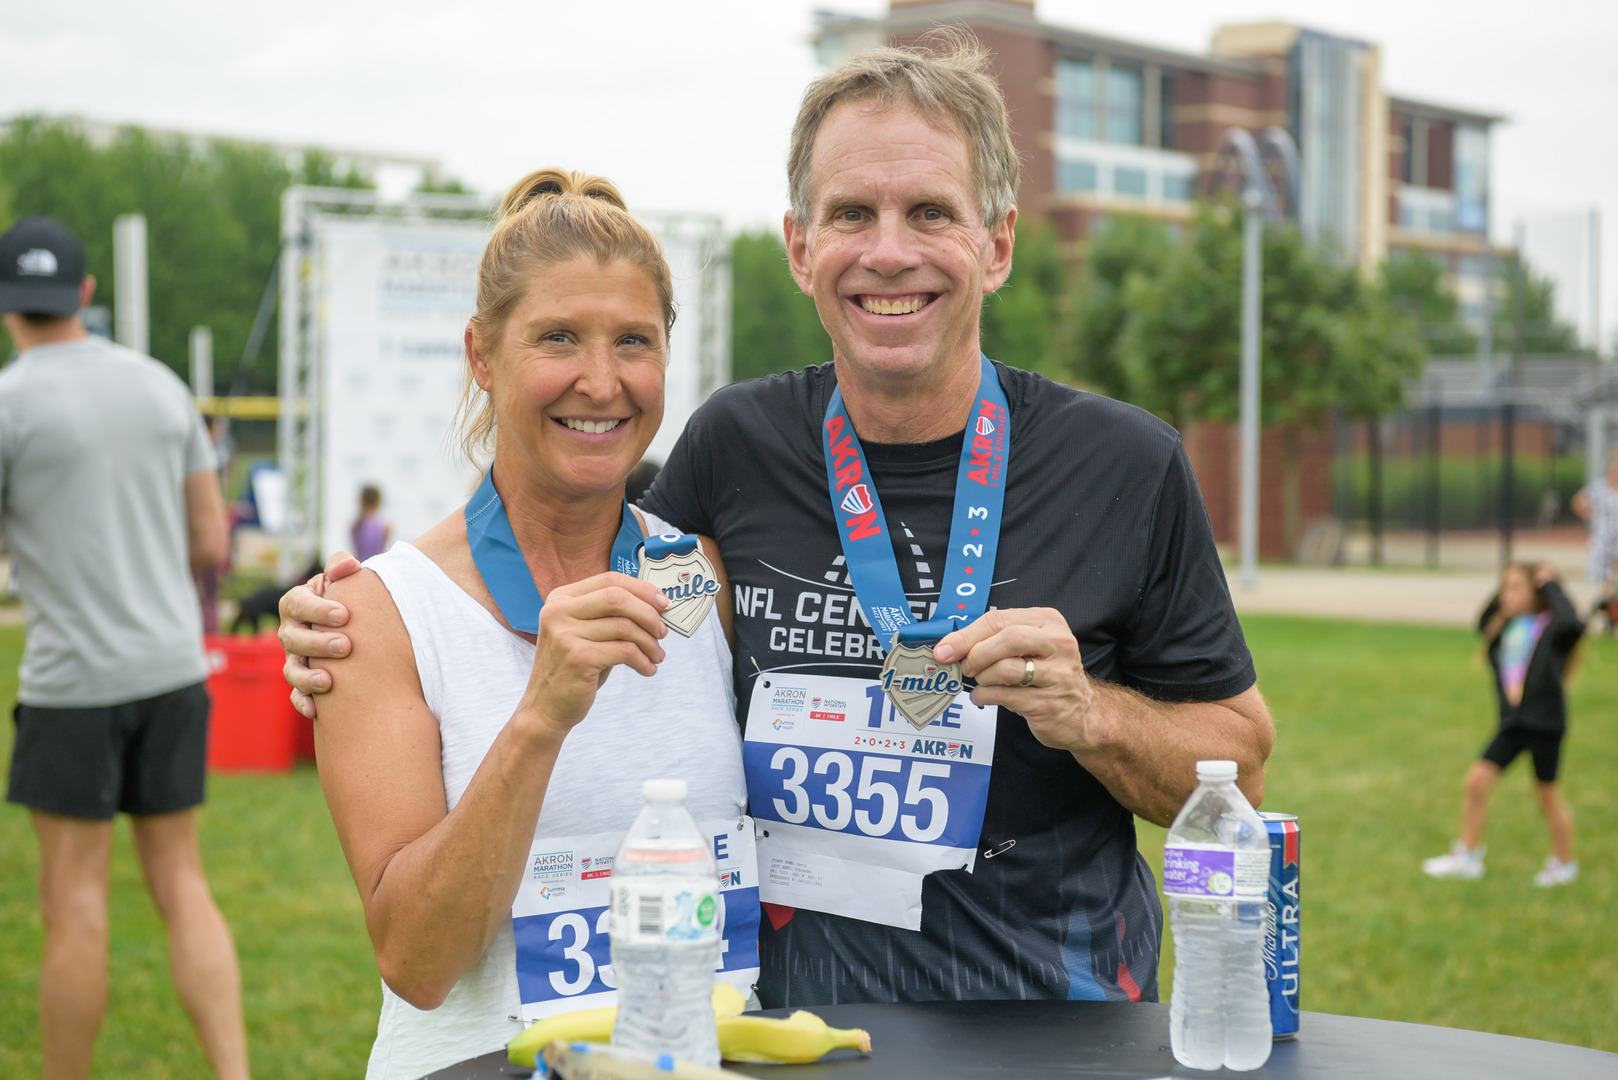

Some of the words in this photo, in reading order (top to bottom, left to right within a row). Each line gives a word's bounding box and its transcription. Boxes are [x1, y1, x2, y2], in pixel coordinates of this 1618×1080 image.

[966, 398, 998, 487] AKRON
[995, 405, 1007, 453] FINISHER
[826, 414, 882, 542] AKRON
[990, 453, 1004, 481] MILE
[735, 584, 782, 621] NFL
[769, 626, 885, 660] CELEBR
[774, 689, 807, 699] AKRON
[881, 668, 963, 694] 1-mile
[772, 698, 805, 706] MARATHON
[866, 684, 885, 728] 1
[911, 738, 974, 759] AKRON
[770, 747, 951, 842] 3355
[533, 863, 573, 872] MARATHON
[534, 854, 573, 865] AKRON
[1165, 857, 1200, 874] rinking
[1281, 876, 1299, 996] ULTRA
